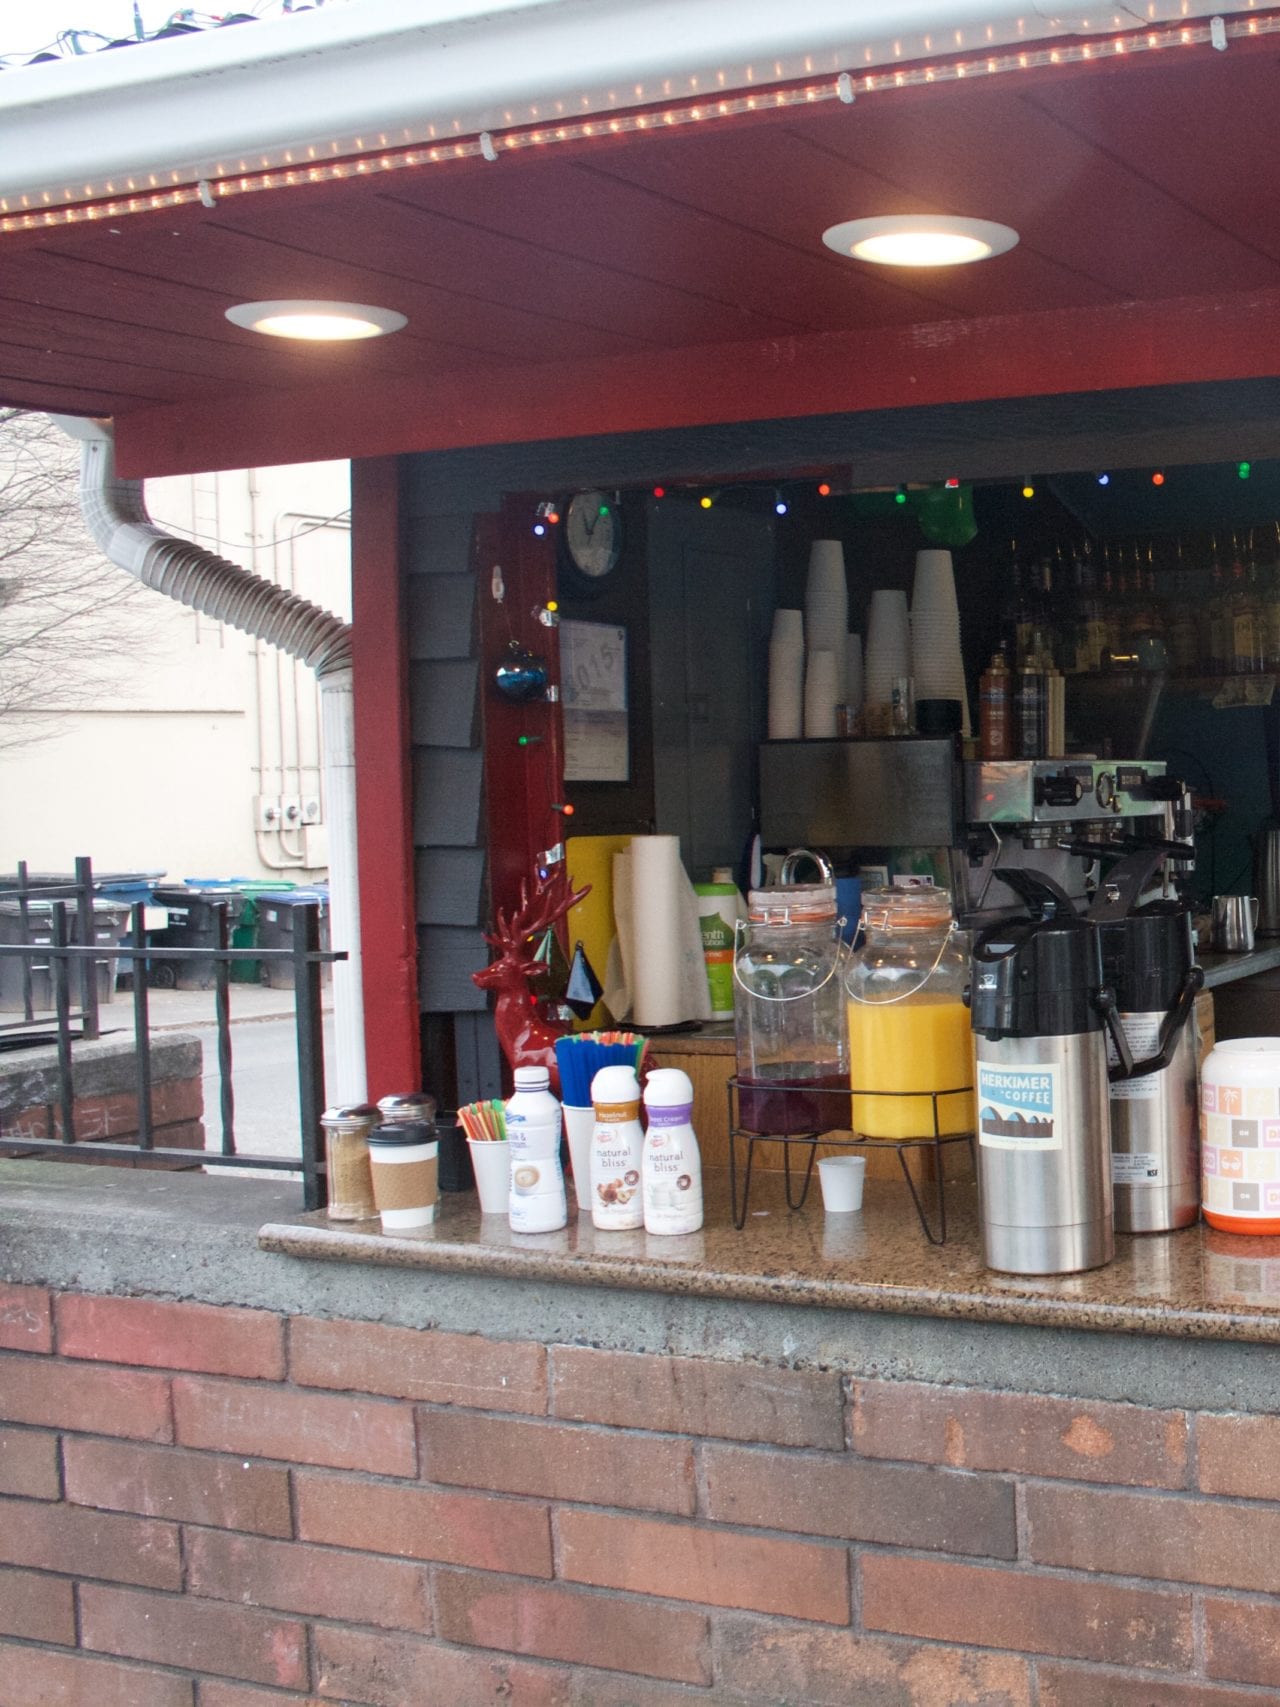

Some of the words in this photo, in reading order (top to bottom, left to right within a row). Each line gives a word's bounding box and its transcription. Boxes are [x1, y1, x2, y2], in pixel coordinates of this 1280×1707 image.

[981, 1071, 1050, 1090] HERKIMER
[1004, 1090, 1050, 1105] COFFEE
[596, 1146, 631, 1157] natural
[649, 1151, 684, 1162] natural
[602, 1158, 626, 1168] bliss
[654, 1163, 679, 1172] bliss
